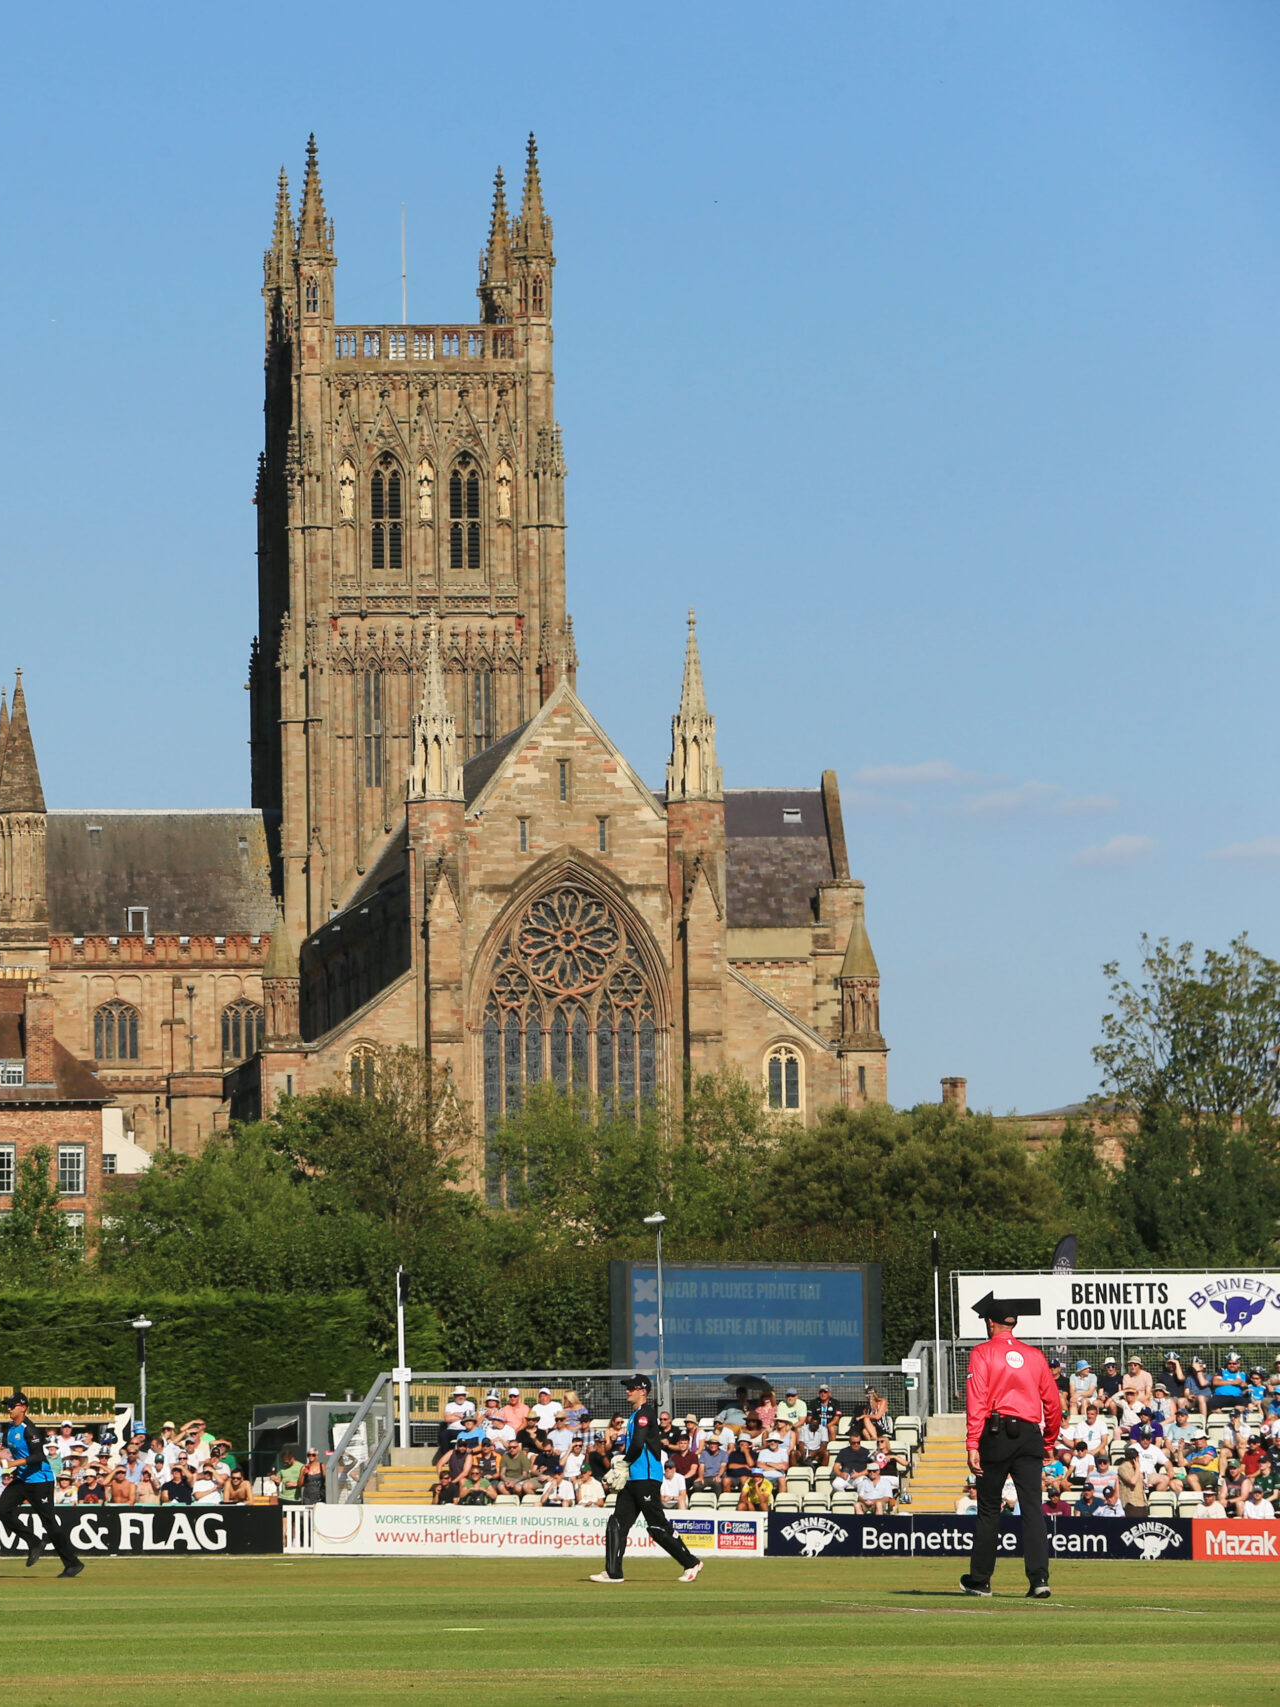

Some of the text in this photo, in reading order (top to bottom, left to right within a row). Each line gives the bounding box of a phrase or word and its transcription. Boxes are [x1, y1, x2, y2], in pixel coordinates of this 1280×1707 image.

[663, 1282, 821, 1300] WEAR A PLUXEE PIRATE HAT
[1072, 1282, 1169, 1305] BENNETTS
[1189, 1277, 1280, 1310] BENNETTS
[663, 1317, 860, 1337] TAKE A SELFIE AT THE PIRATE WALL
[1056, 1308, 1187, 1331] FOOD VILLAGE
[28, 1396, 116, 1415] BURGER
[70, 1513, 109, 1550] &
[118, 1512, 227, 1551] FLAG
[374, 1514, 471, 1525] WORCESTERSHIRE'S
[474, 1515, 518, 1526] PREMIER
[520, 1516, 580, 1527] INDUSTRIAL
[582, 1517, 590, 1527] &
[780, 1516, 849, 1543] BENNETTS
[862, 1526, 974, 1550] Bennetts
[1120, 1521, 1184, 1546] BENNETTS
[1205, 1530, 1279, 1556] Mazak
